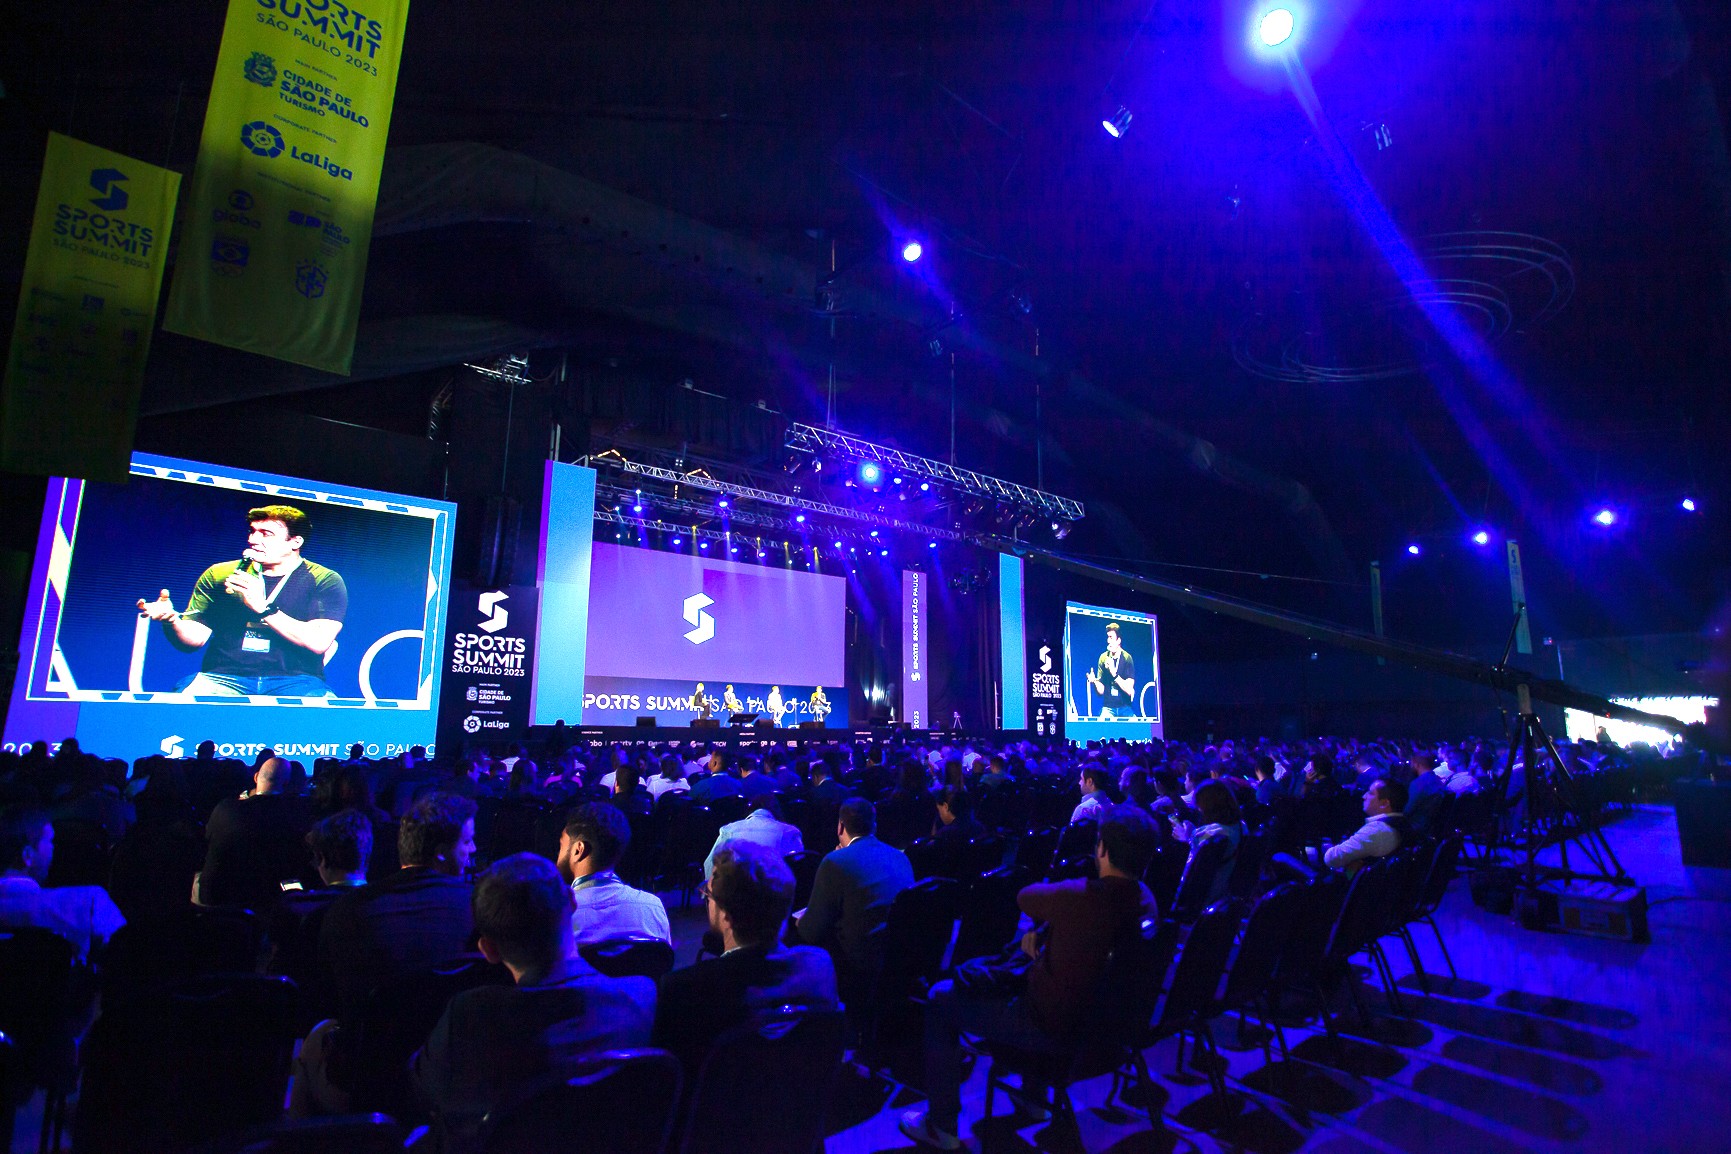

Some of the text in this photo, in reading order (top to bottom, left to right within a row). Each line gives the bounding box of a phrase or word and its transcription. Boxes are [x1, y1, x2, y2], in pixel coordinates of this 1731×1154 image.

[256, 13, 378, 77] SÃO PAULO 2023
[283, 69, 352, 107] CIDADE DE
[279, 92, 326, 117] TURISMO
[280, 80, 369, 128] SÃO PAULO
[290, 146, 353, 181] LaLiga
[56, 203, 153, 243] SPORTS
[53, 219, 152, 257] SUMMIT
[81, 245, 120, 262] PAULO
[453, 632, 526, 653] SPORTS
[452, 648, 525, 669] SUMMIT
[451, 664, 525, 677] SÃO PAULO 2023
[1032, 672, 1060, 685] SPORTS
[1032, 683, 1060, 694] SUMMIT
[483, 720, 510, 730] LaLiga
[3, 742, 63, 757] 203
[274, 743, 340, 756] SUMMIT
